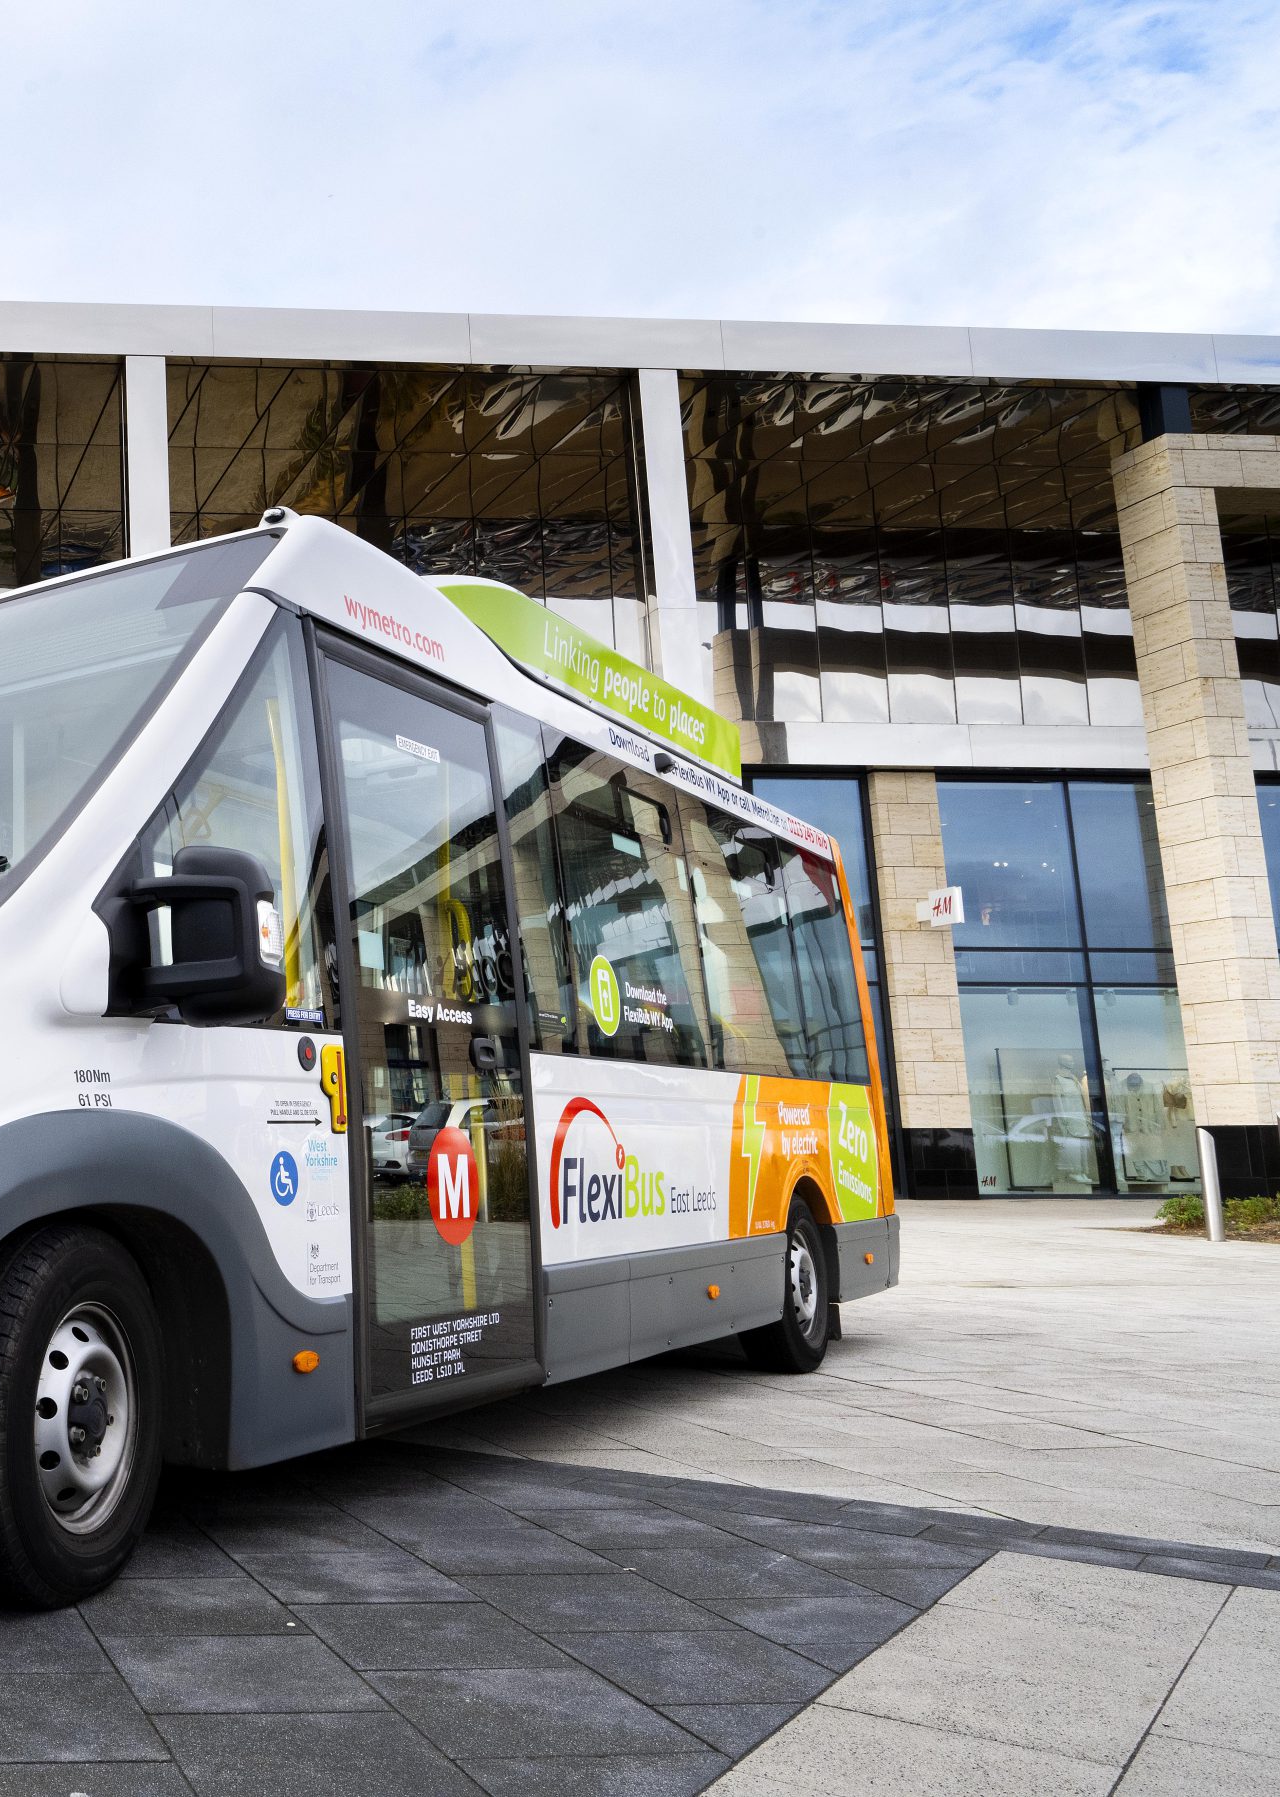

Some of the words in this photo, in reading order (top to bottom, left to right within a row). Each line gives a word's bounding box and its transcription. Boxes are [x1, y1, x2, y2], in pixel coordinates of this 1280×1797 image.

[343, 594, 445, 662] wymetro.com
[543, 619, 600, 693] Linking
[603, 665, 650, 713] people
[653, 693, 666, 722] to
[669, 700, 705, 745] places
[608, 727, 650, 762] Download
[704, 774, 716, 795] WY
[717, 782, 731, 806] App
[931, 895, 952, 917] H&M
[624, 981, 657, 1003] Download
[657, 988, 668, 1005] the
[287, 1009, 300, 1019] PRESS
[300, 1010, 309, 1019] FOR
[308, 1011, 321, 1021] ENTRY
[407, 999, 434, 1024] Easy
[436, 1003, 474, 1025] Access
[623, 1006, 651, 1026] FlexiBus
[650, 1010, 661, 1027] WY
[661, 1012, 674, 1032] App
[73, 1069, 111, 1083] 180Nm
[78, 1093, 91, 1107] 61
[93, 1093, 113, 1107] PSI
[777, 1100, 811, 1126] Powered
[838, 1100, 869, 1163] Zero
[307, 1138, 327, 1152] West
[781, 1130, 790, 1161] by
[791, 1130, 819, 1155] electric
[304, 1153, 338, 1167] Yorkshire
[437, 1153, 471, 1219] M
[562, 1153, 666, 1225] FlexiBus
[670, 1186, 690, 1214] East
[692, 1185, 717, 1212] Leeds
[838, 1159, 873, 1204] Emissions
[317, 1202, 340, 1217] Leeds
[309, 1262, 339, 1274] Department
[309, 1275, 317, 1286] for
[318, 1274, 341, 1286] Transport
[410, 1325, 431, 1340] FIRST
[432, 1321, 452, 1336] WEST
[452, 1314, 488, 1332] YORKSHIRE
[488, 1312, 500, 1325] LTD
[411, 1334, 458, 1355] DONISTHORPE
[459, 1329, 483, 1345] STREET
[411, 1352, 442, 1370] HUNSLET
[443, 1347, 461, 1363] PARK
[412, 1369, 434, 1385] LEEDS
[436, 1363, 453, 1379] LS10
[453, 1361, 466, 1375] 1PL
